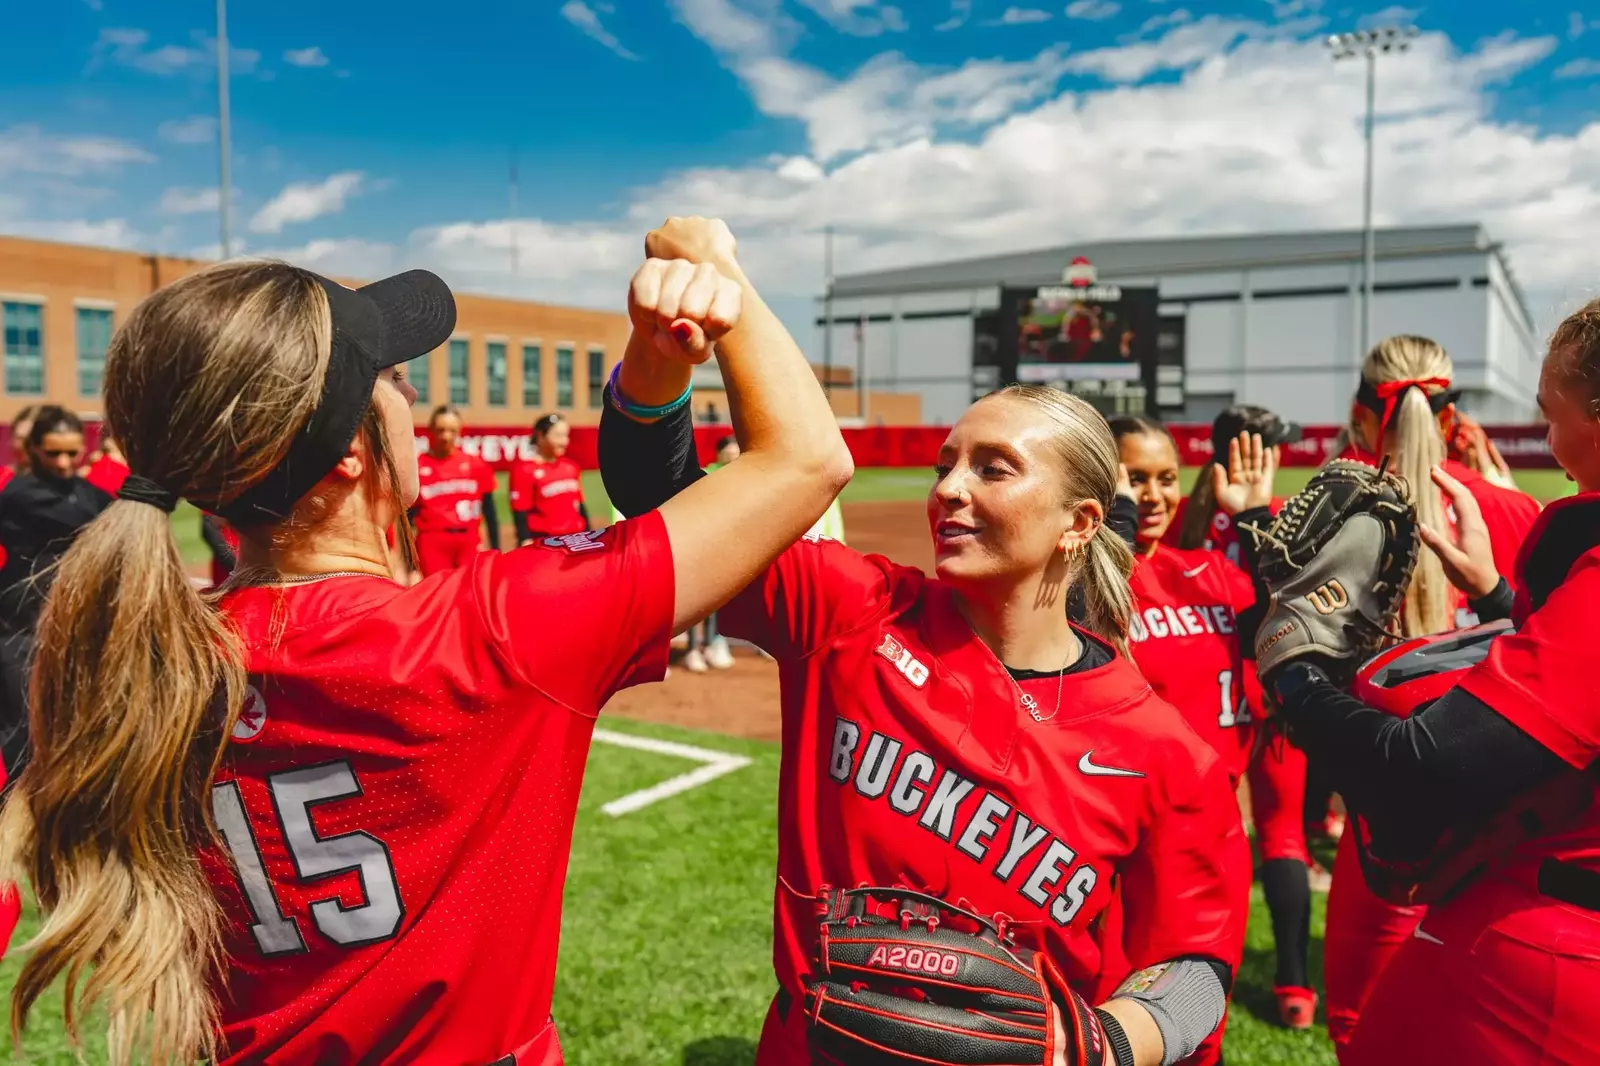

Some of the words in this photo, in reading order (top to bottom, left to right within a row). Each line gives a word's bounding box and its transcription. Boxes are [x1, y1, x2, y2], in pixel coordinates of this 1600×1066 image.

[211, 757, 407, 958] 15
[828, 715, 1098, 927] BUCKEYES
[866, 942, 960, 978] A2000
